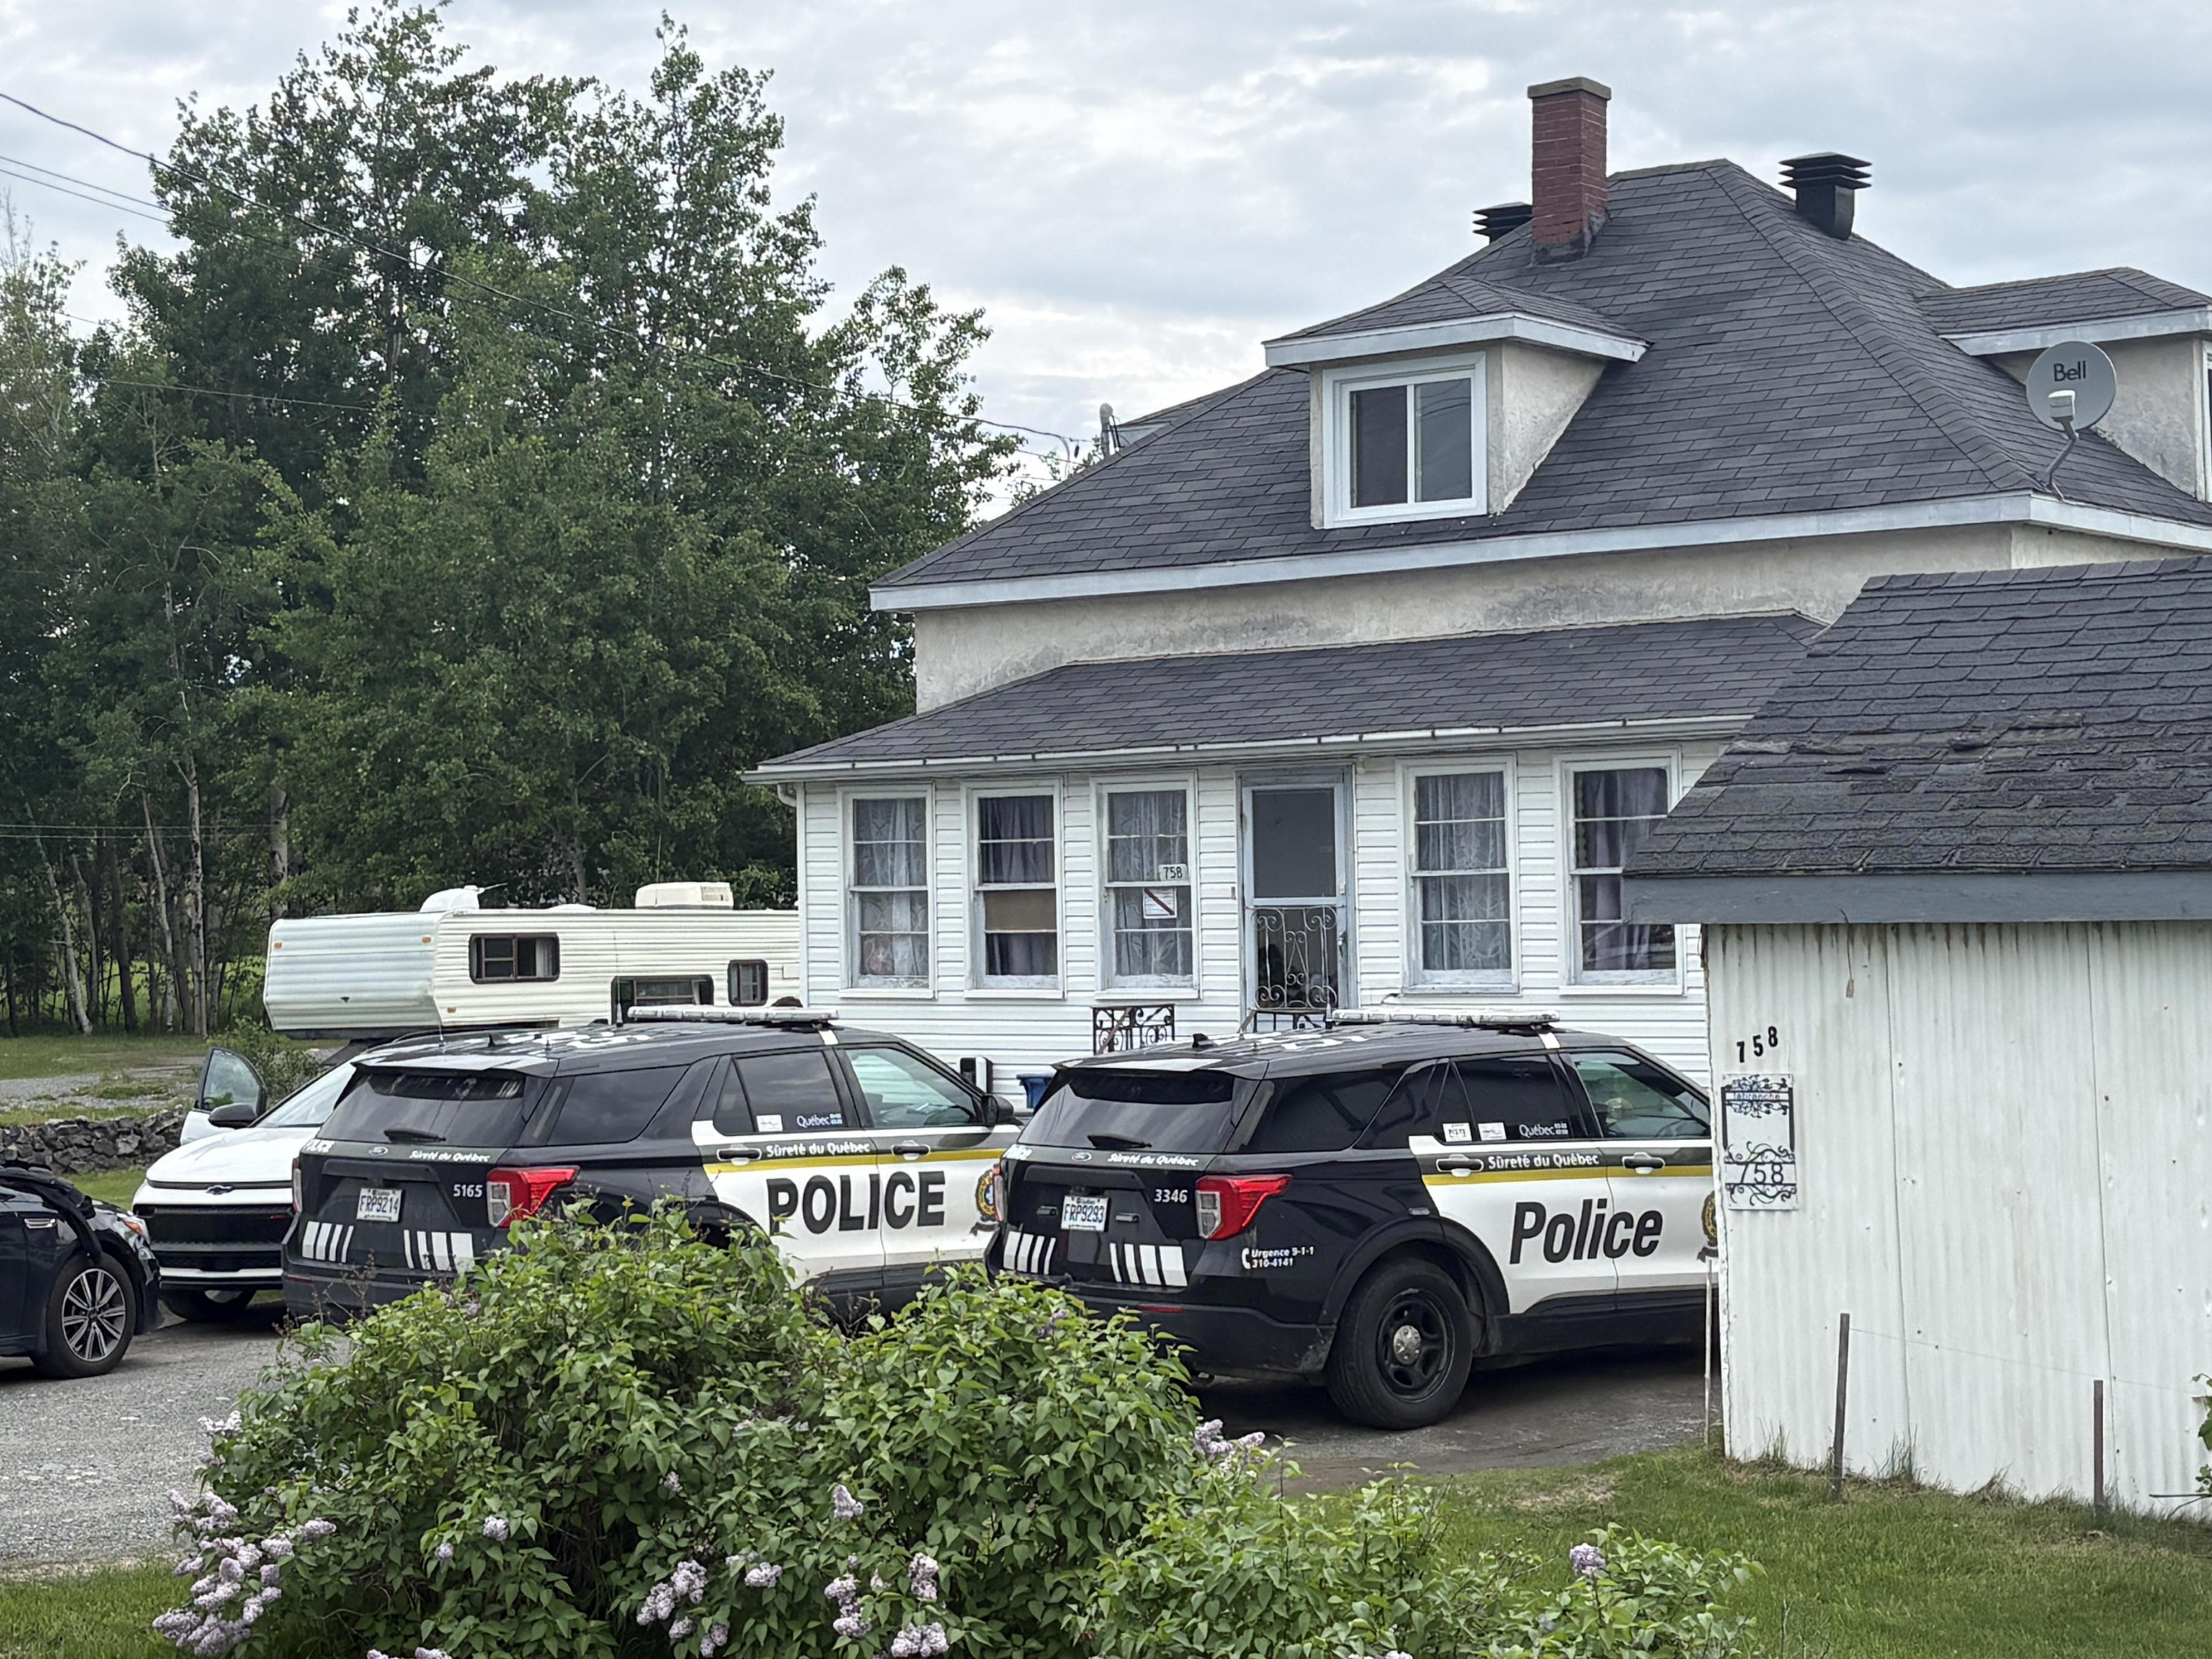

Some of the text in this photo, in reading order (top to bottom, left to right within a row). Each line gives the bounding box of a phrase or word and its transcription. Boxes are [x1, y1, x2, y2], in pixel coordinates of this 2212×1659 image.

[2054, 360, 2087, 382] Bell
[1163, 866, 1182, 879] 758
[1736, 1026, 1778, 1063] 758
[797, 1116, 830, 1128] Québec
[1519, 1123, 1555, 1138] Québec
[766, 1141, 870, 1158] Sûreté du Québec
[1488, 1152, 1600, 1169] Sûreté du Québec
[1735, 1161, 1784, 1185] 758
[453, 1184, 484, 1198] 5165
[1154, 1189, 1189, 1203] 3346
[360, 1195, 399, 1214] FRP9214
[766, 1170, 945, 1236] POLICE
[1064, 1204, 1105, 1223] FRP9293
[1509, 1198, 1663, 1265] Police
[1252, 1249, 1290, 1259] Urgence
